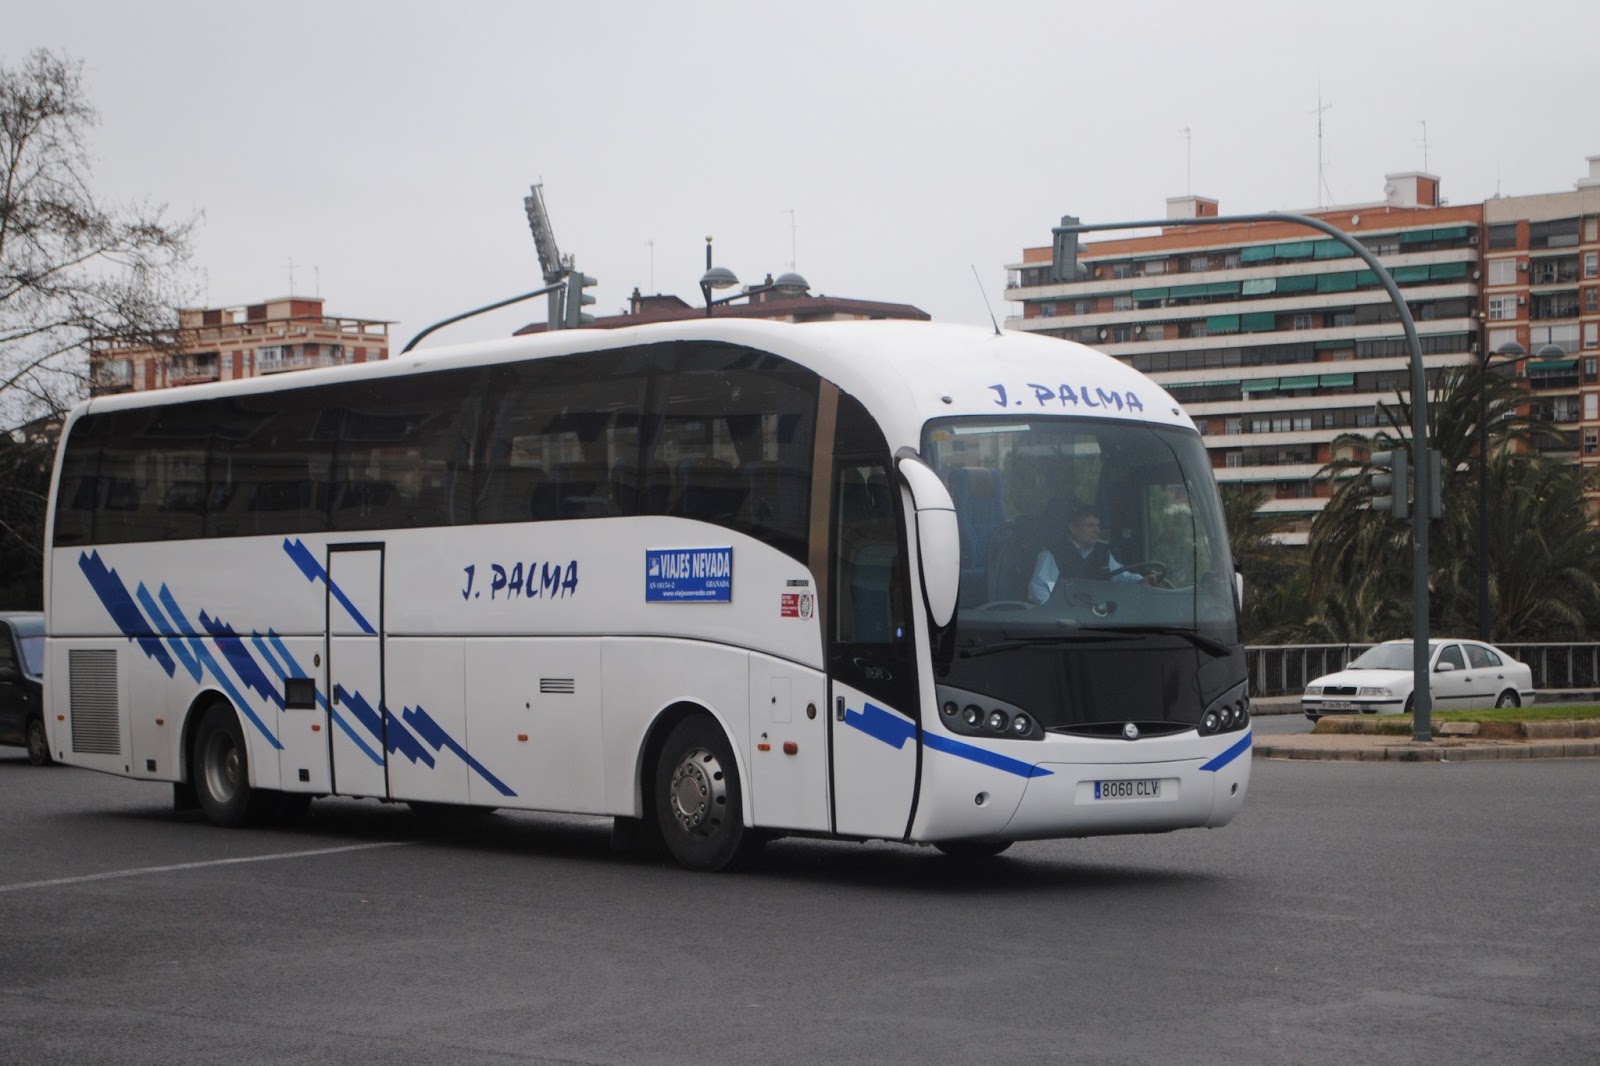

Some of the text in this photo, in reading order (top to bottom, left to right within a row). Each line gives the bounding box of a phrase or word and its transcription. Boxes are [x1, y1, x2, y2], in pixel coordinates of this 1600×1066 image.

[987, 384, 1144, 413] J. PALMA
[660, 552, 730, 579] VIAJES NEVADA
[462, 560, 579, 600] J. PALMA
[705, 580, 730, 588] GRANADA
[1102, 780, 1159, 797] 8060 CLV
